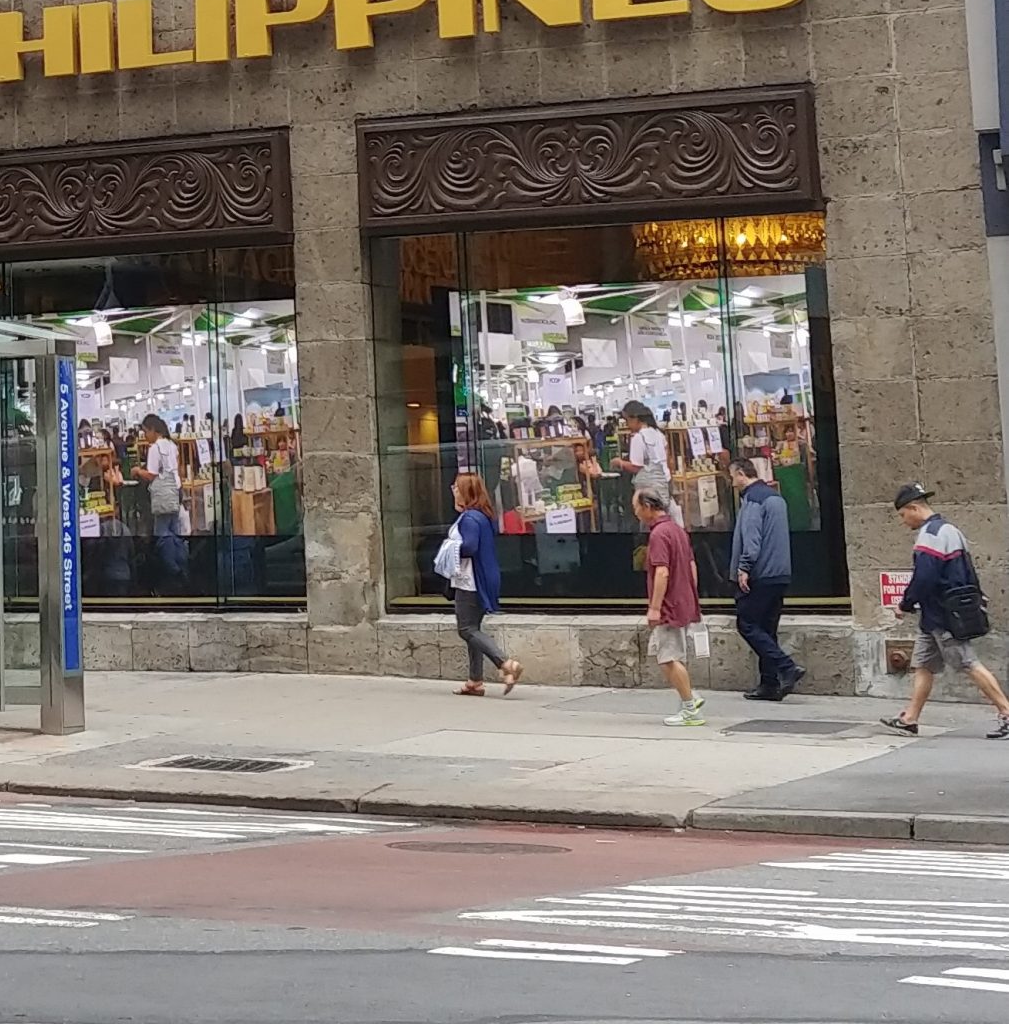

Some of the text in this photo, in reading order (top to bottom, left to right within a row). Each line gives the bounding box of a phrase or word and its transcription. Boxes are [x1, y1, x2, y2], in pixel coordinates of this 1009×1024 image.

[60, 383, 72, 611] 5 Avenue & West 46 Street
[888, 573, 912, 584] STANDP
[883, 584, 908, 595] FOR FIR
